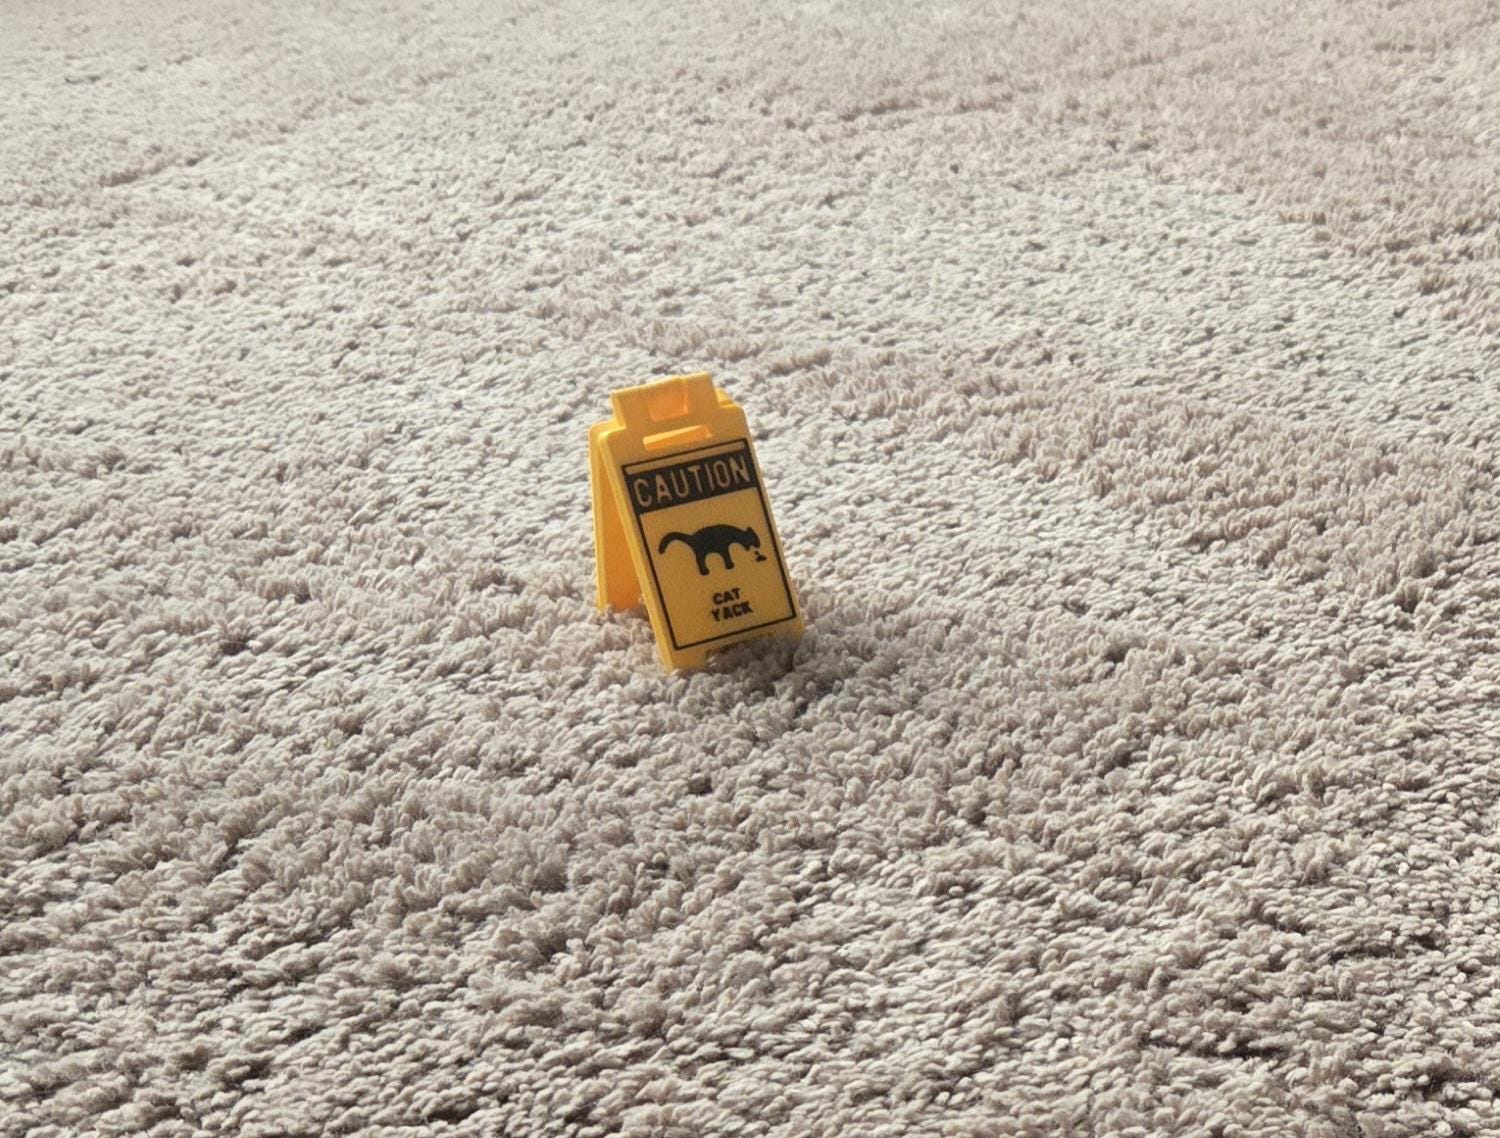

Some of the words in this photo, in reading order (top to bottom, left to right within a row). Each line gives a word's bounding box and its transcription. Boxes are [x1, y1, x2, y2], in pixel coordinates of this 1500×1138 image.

[633, 455, 750, 507] CAUTION
[713, 588, 741, 605] CAT
[711, 602, 753, 622] YACK
